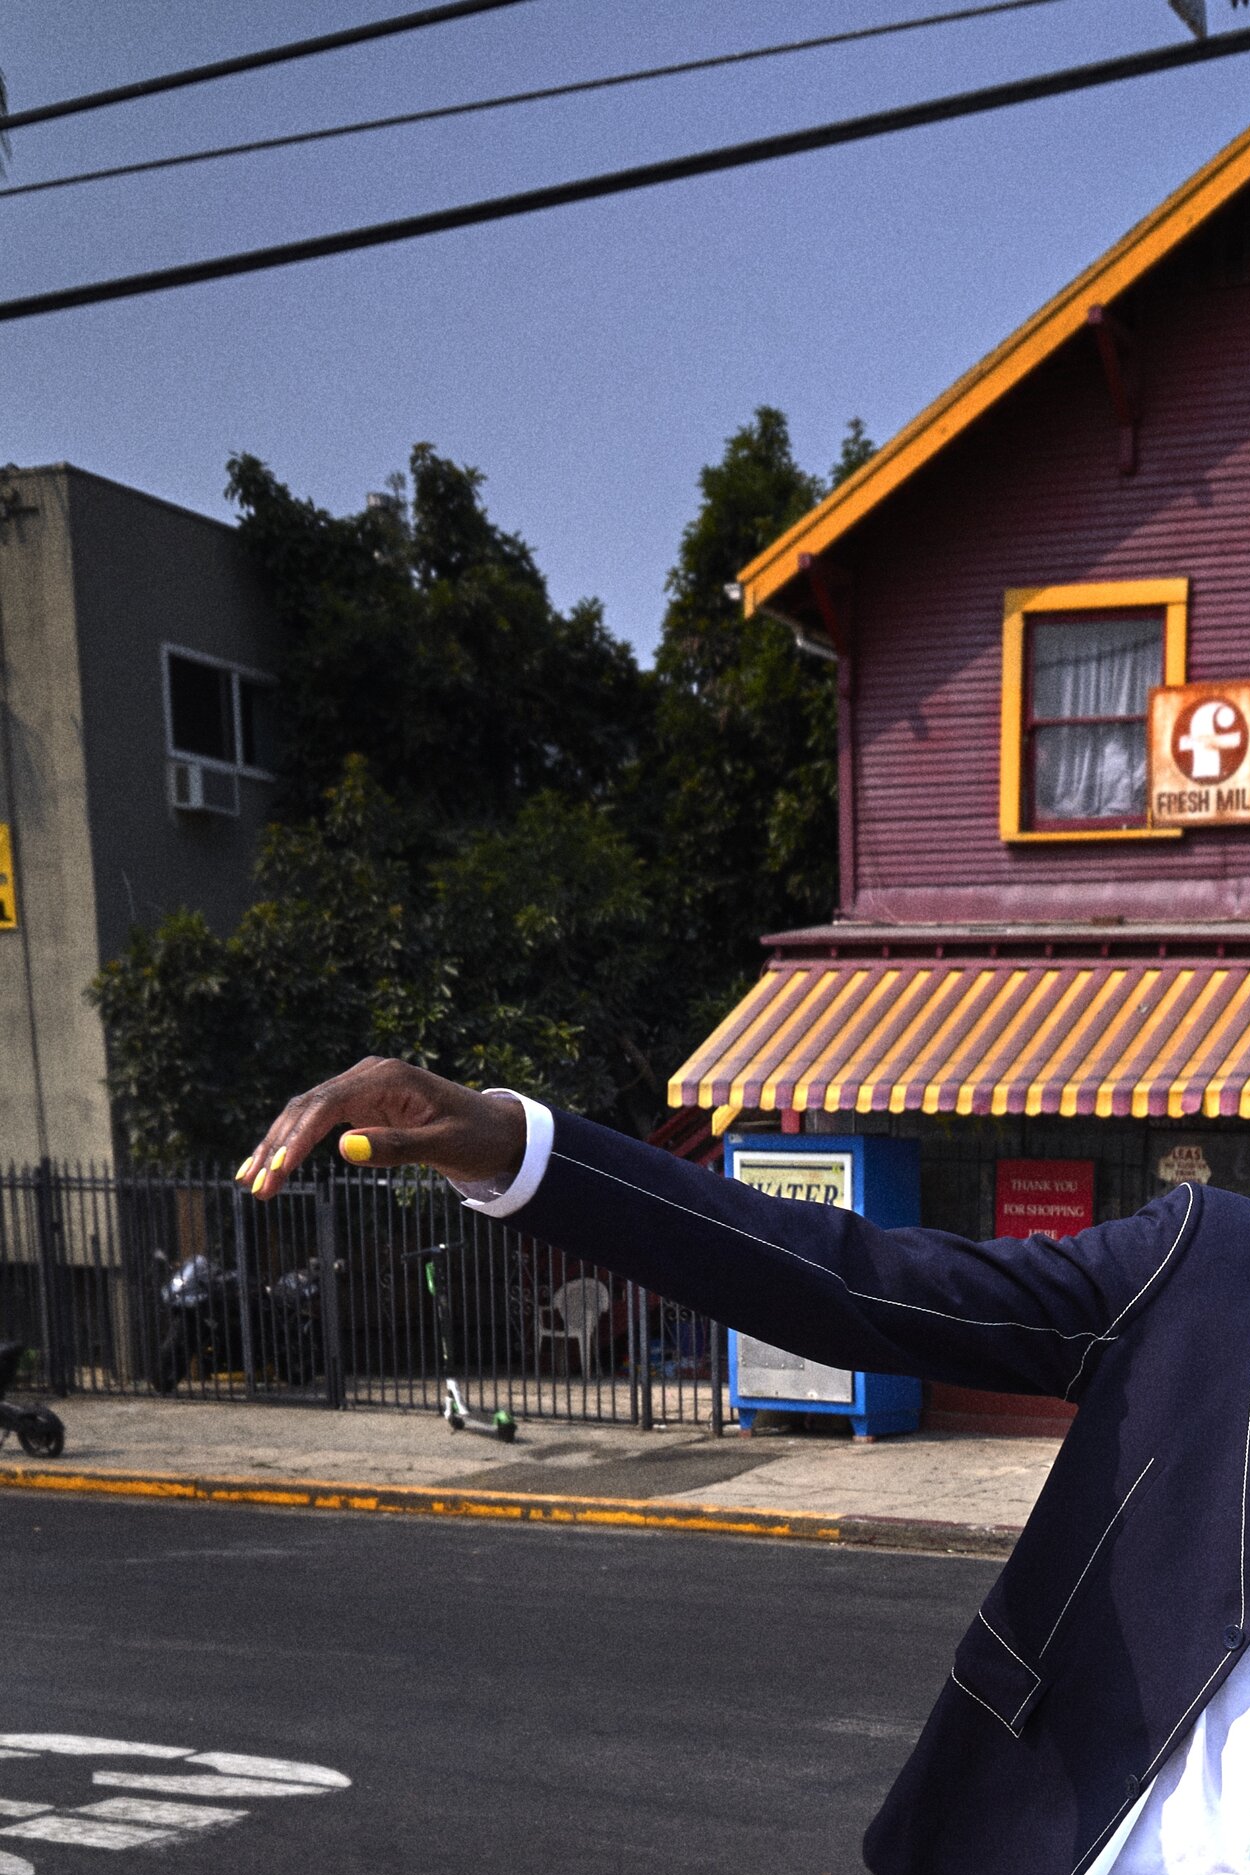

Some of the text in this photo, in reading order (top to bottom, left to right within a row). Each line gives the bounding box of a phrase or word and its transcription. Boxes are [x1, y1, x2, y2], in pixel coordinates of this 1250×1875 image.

[1156, 789, 1210, 815] FRESH
[1011, 1179, 1079, 1193] THANK YOU
[1003, 1203, 1085, 1218] FOR SHOPPING
